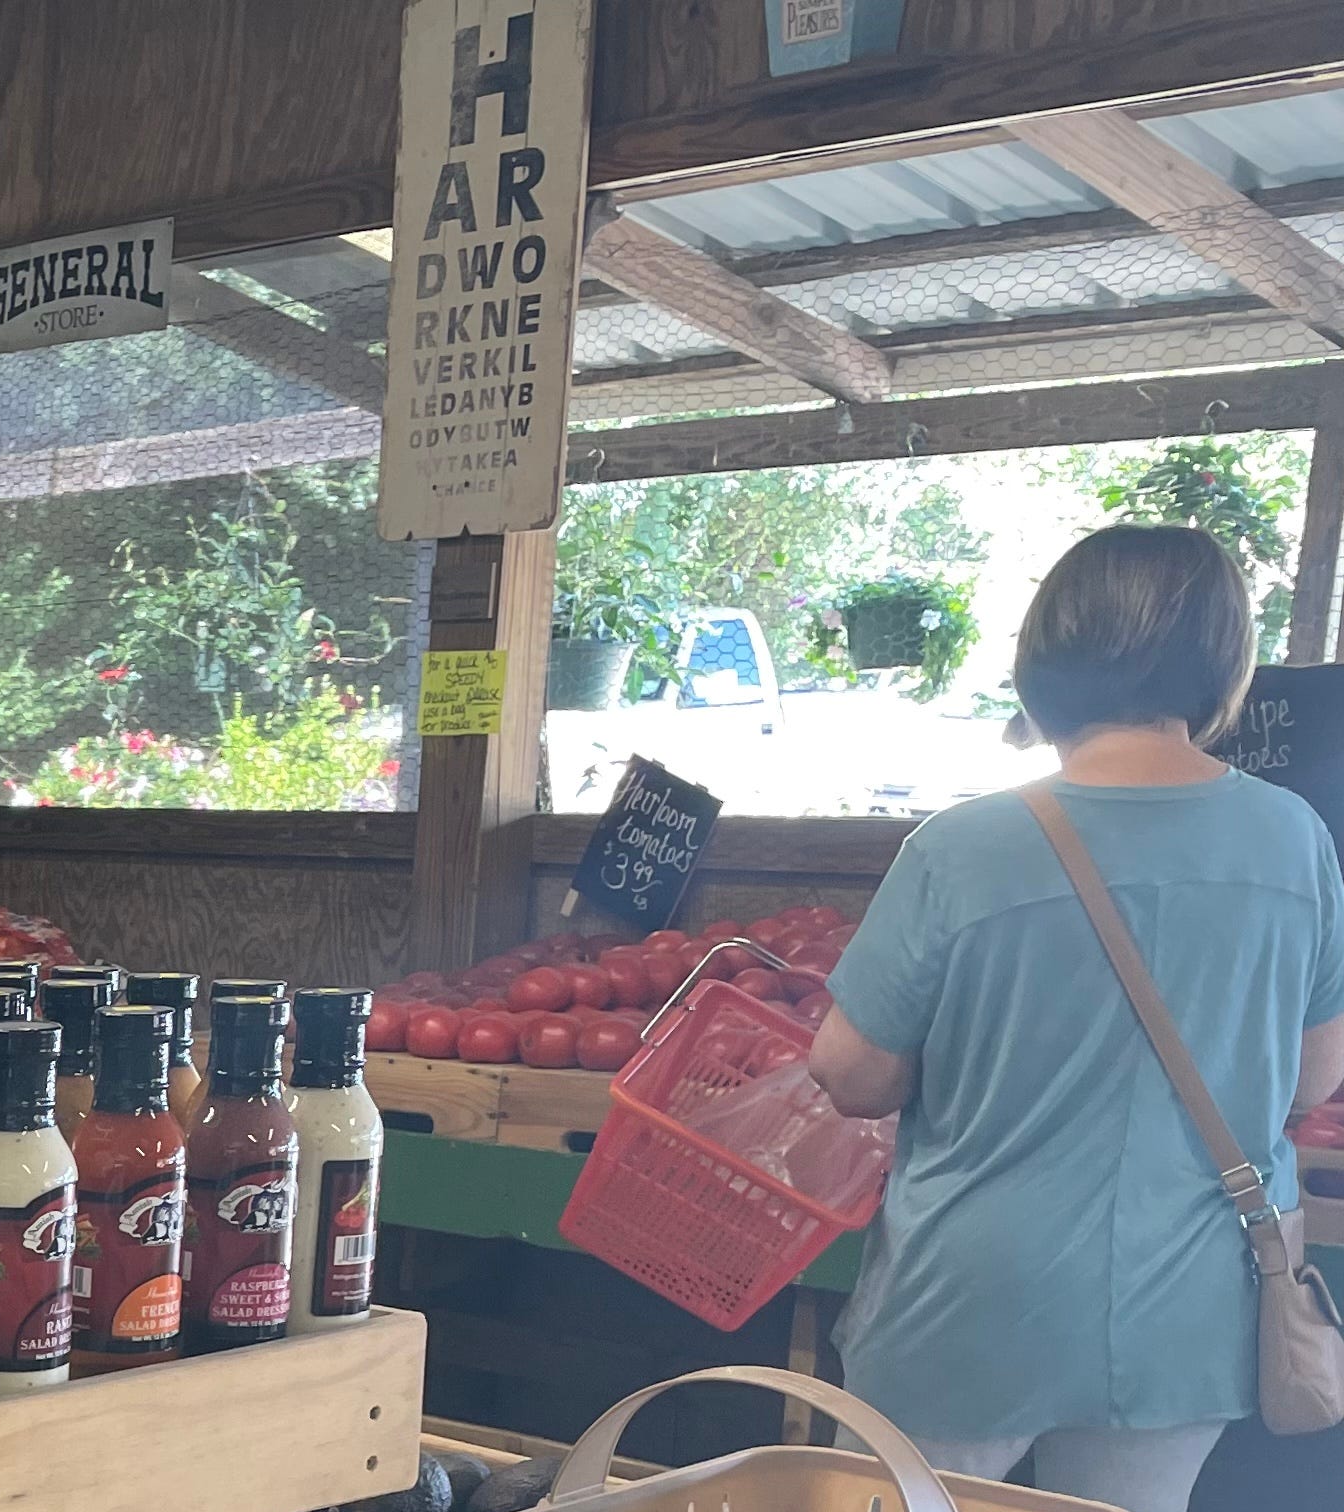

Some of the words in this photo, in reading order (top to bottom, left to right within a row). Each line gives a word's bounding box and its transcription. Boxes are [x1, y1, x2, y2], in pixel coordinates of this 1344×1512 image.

[450, 13, 534, 148] H
[416, 235, 546, 300] DWO
[38, 305, 97, 333] STORE
[415, 294, 542, 350] RKNE
[618, 771, 698, 850] Heirloom
[212, 1306, 252, 1317] SALAD
[220, 1293, 261, 1305] SWEET
[120, 1319, 156, 1331] SALAD
[20, 1337, 57, 1351] SALAD
